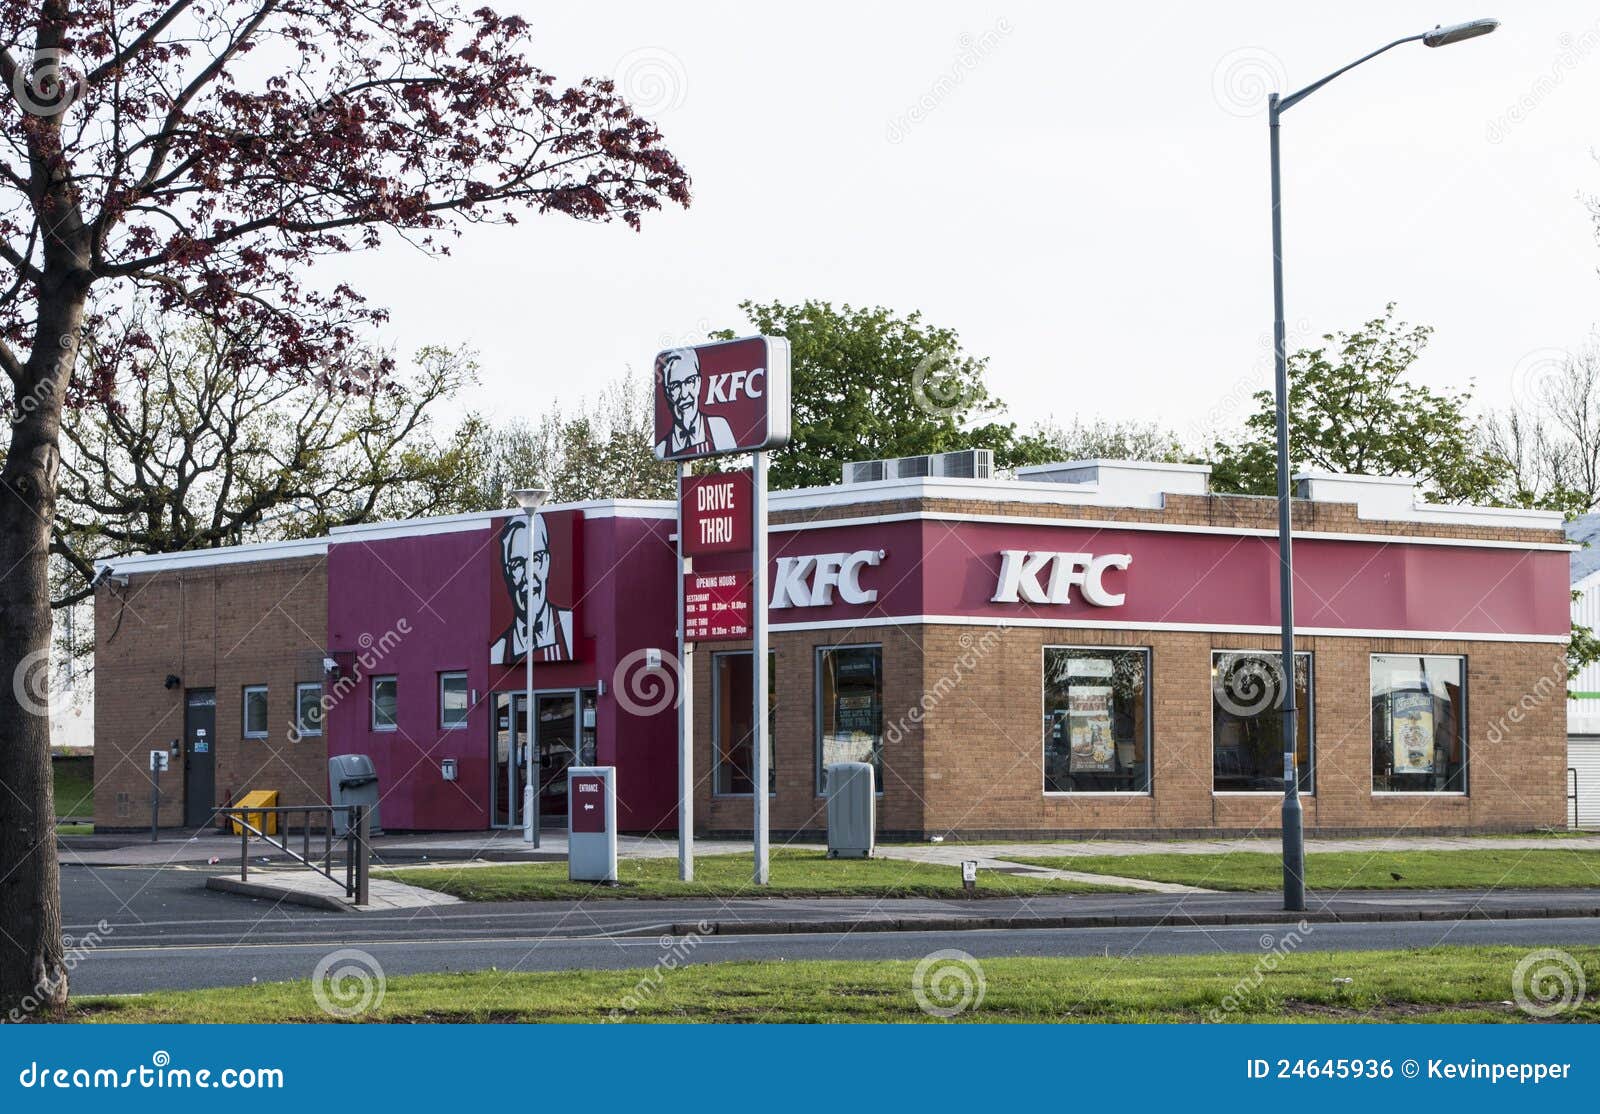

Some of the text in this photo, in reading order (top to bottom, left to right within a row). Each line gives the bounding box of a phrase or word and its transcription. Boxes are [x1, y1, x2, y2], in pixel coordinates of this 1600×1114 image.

[704, 367, 765, 406] KFC
[697, 483, 735, 512] DRIVE
[699, 516, 733, 545] THRU
[696, 575, 736, 589] OPENING HOURS
[769, 549, 880, 610] KFC
[990, 549, 1129, 607] KFC
[686, 593, 709, 603] RESTAURANT
[686, 604, 695, 612] MON
[699, 603, 707, 612] SUN
[686, 617, 708, 627] DRIVE THRU
[686, 628, 695, 637] MON
[699, 628, 707, 636] SUN
[579, 783, 598, 793] ENTRANCE
